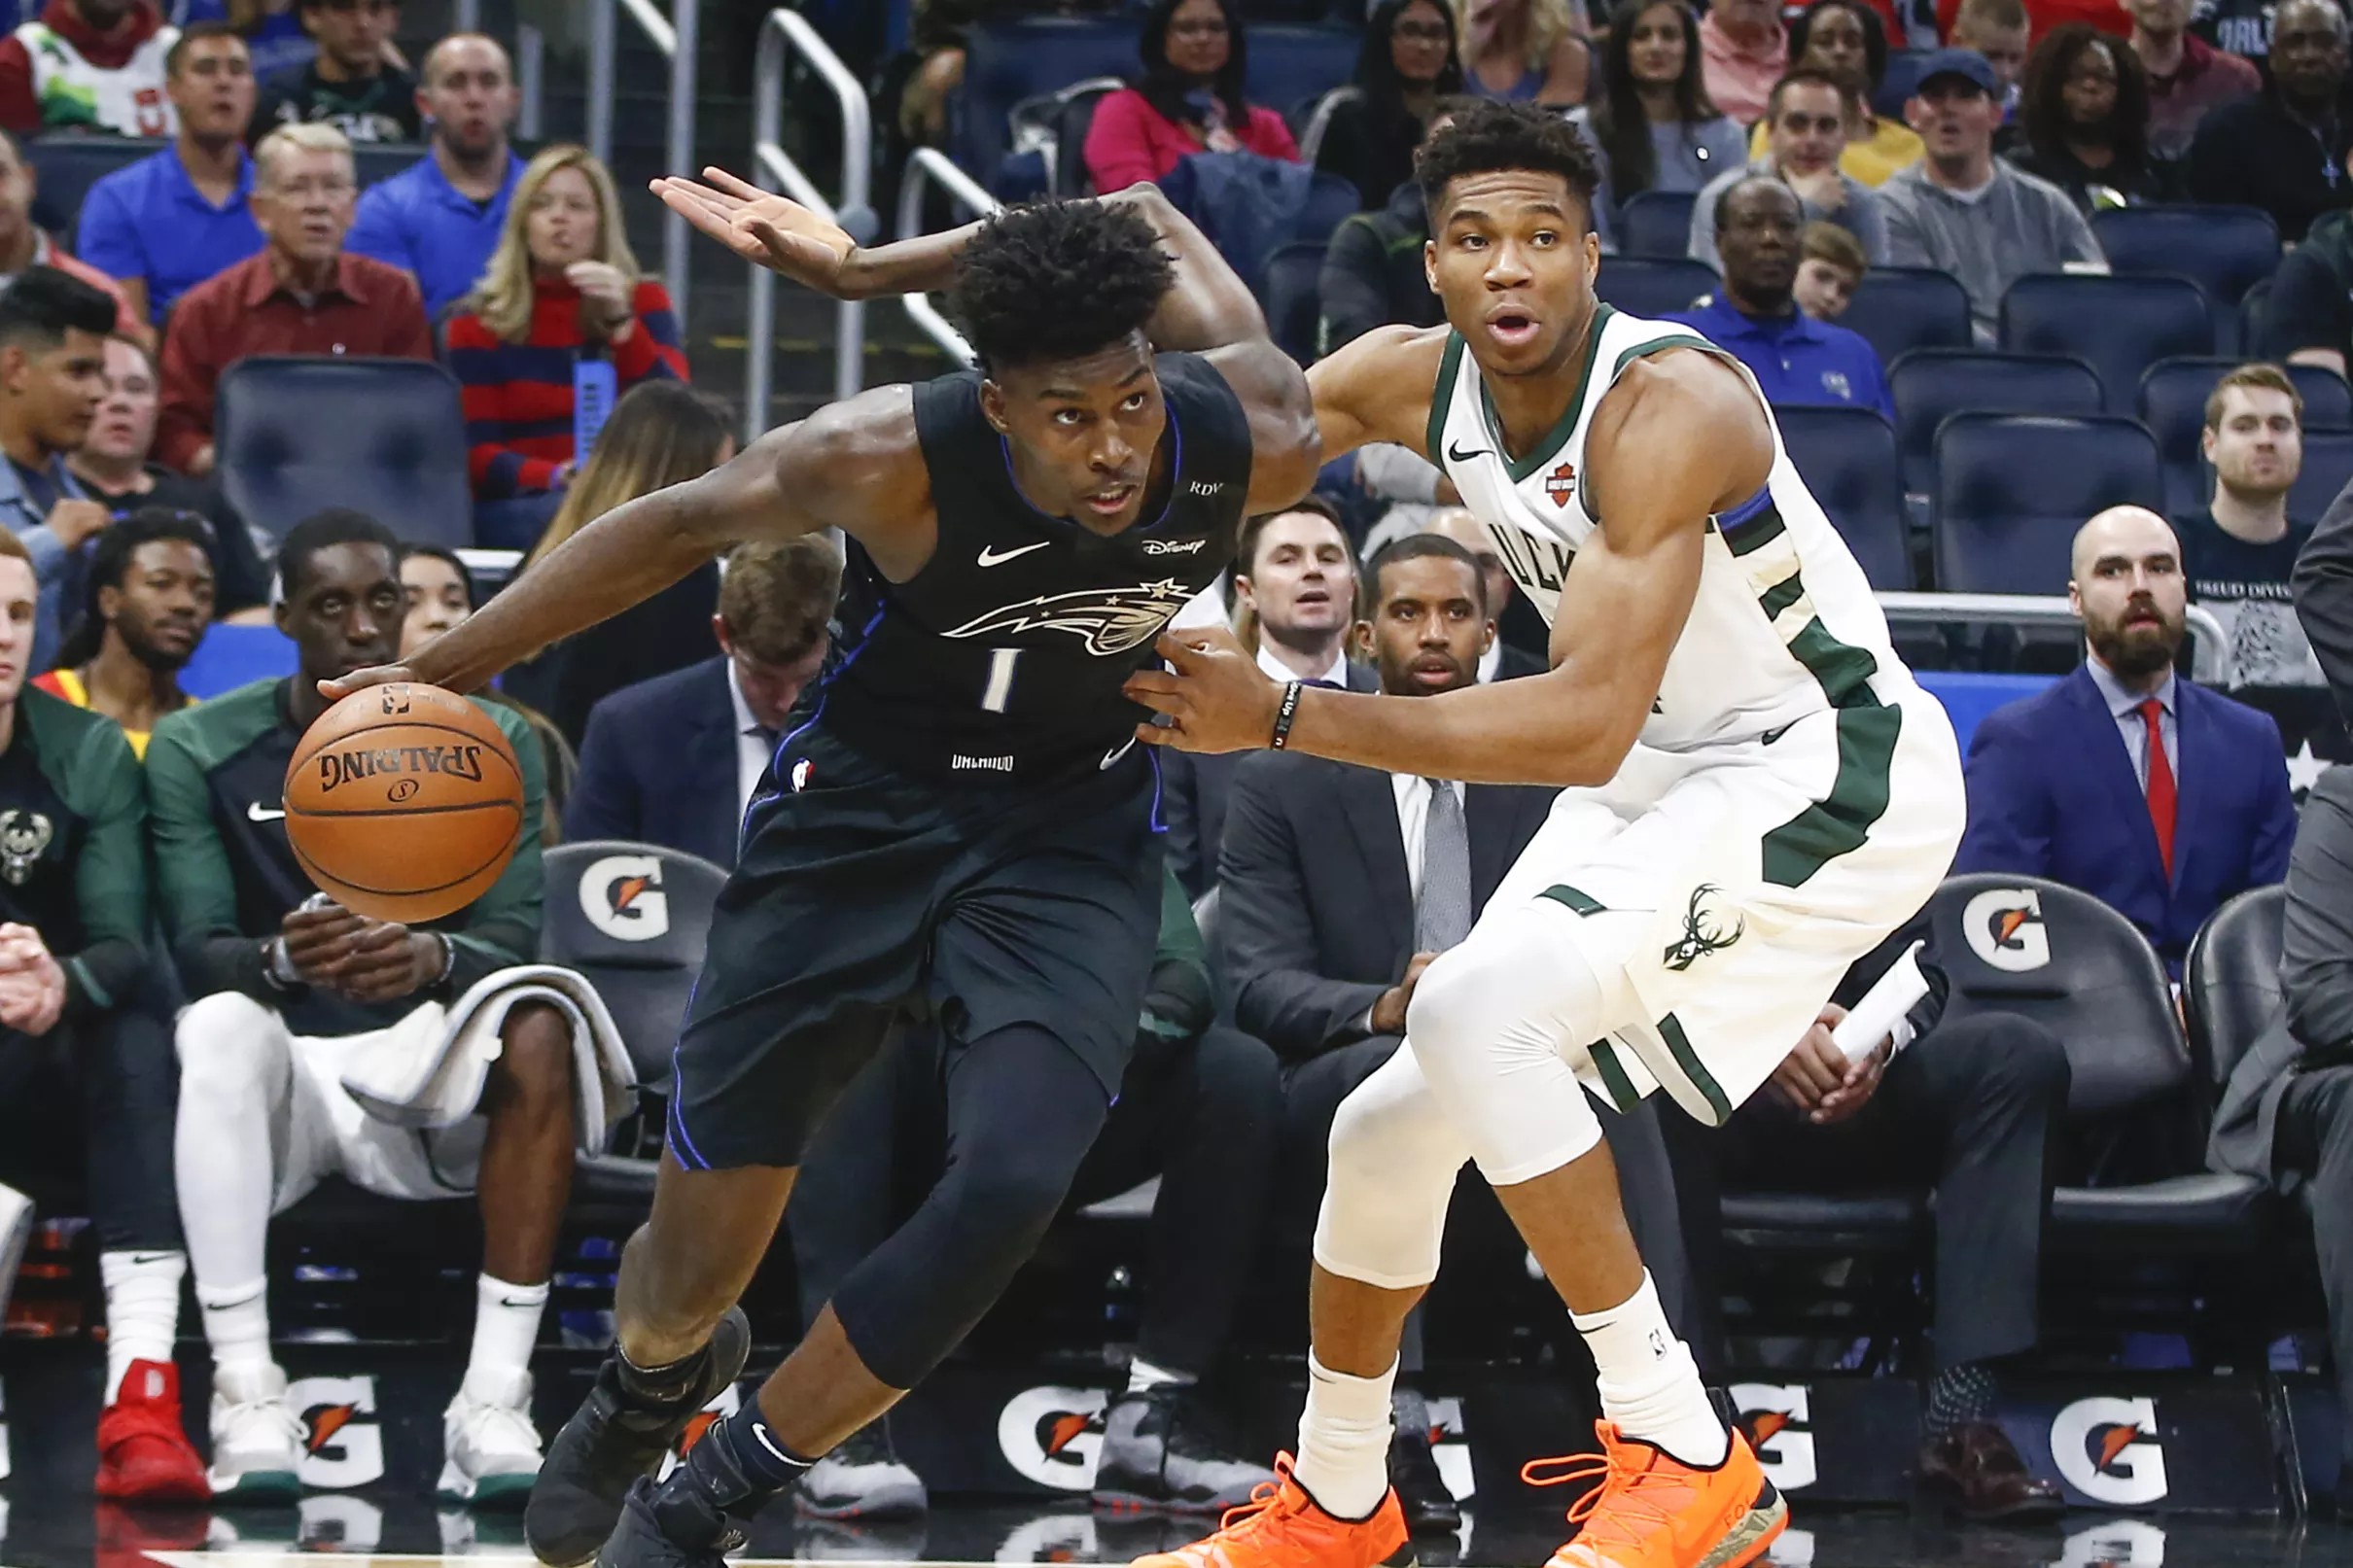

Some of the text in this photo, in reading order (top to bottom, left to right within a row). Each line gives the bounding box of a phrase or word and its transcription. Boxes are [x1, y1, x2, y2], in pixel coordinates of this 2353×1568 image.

[1189, 480, 1224, 496] RDV
[1141, 540, 1206, 555] Disney
[981, 647, 1026, 713] 1
[318, 746, 482, 792] SPALDING
[579, 855, 669, 941] G
[1962, 889, 2051, 972] G
[288, 1376, 384, 1488] G
[998, 1385, 1107, 1490] G
[2050, 1396, 2168, 1505] G
